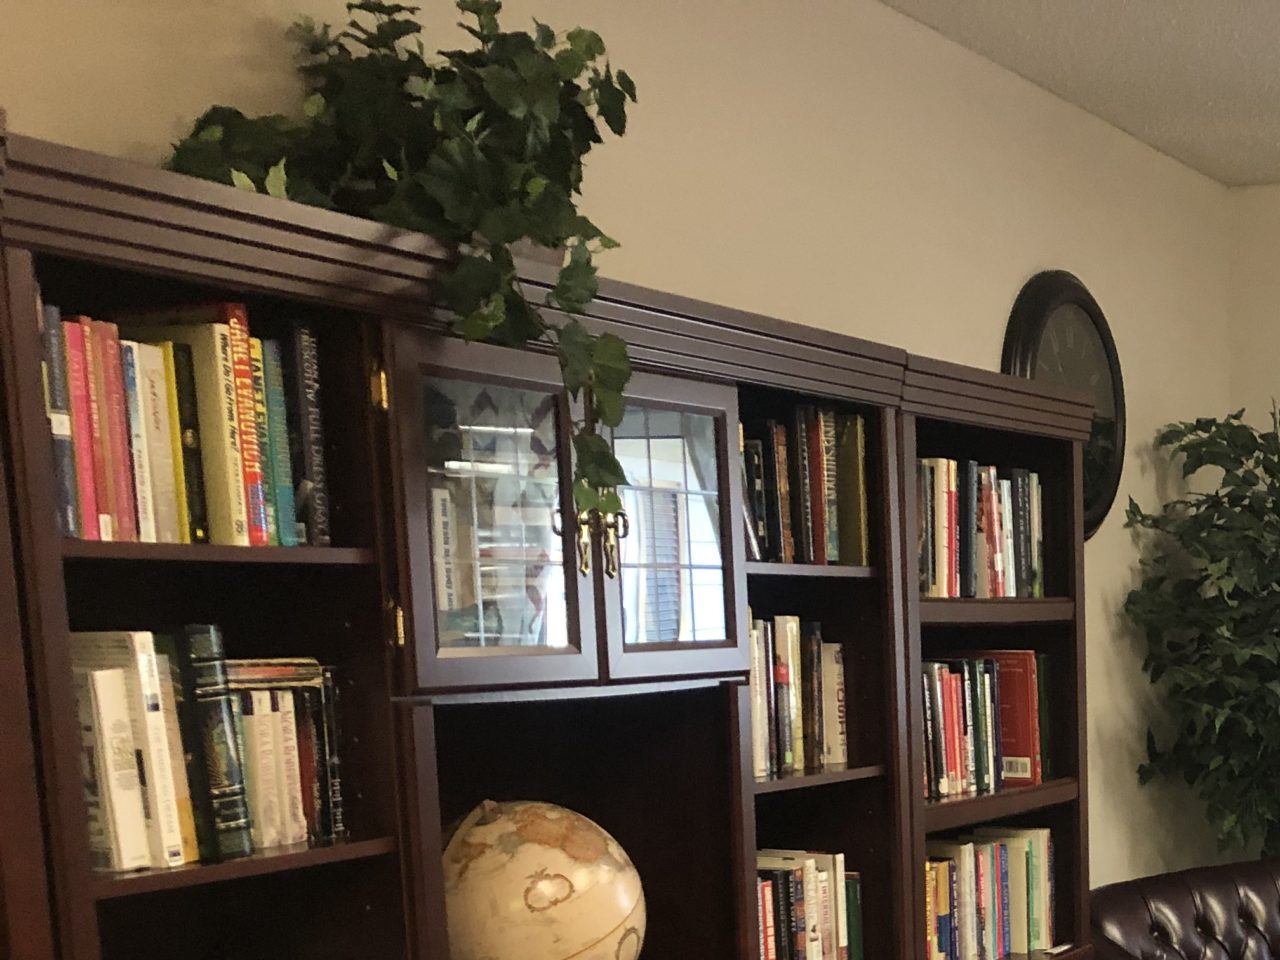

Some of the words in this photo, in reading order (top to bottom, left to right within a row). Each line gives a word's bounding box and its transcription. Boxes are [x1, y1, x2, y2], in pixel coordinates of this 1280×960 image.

[218, 331, 231, 362] Where
[228, 316, 250, 372] JANET
[221, 362, 233, 377] Do
[250, 356, 267, 411] JANET
[223, 382, 235, 397] Go
[224, 395, 237, 422] From
[234, 375, 261, 474] EVANOVICH
[306, 405, 322, 441] FULL
[226, 423, 239, 454] Here?
[309, 443, 327, 489] DRESS
[824, 450, 837, 499] SHELDON
[313, 491, 331, 531] GRAY
[256, 713, 272, 746] NORA
[279, 710, 294, 743] NORA
